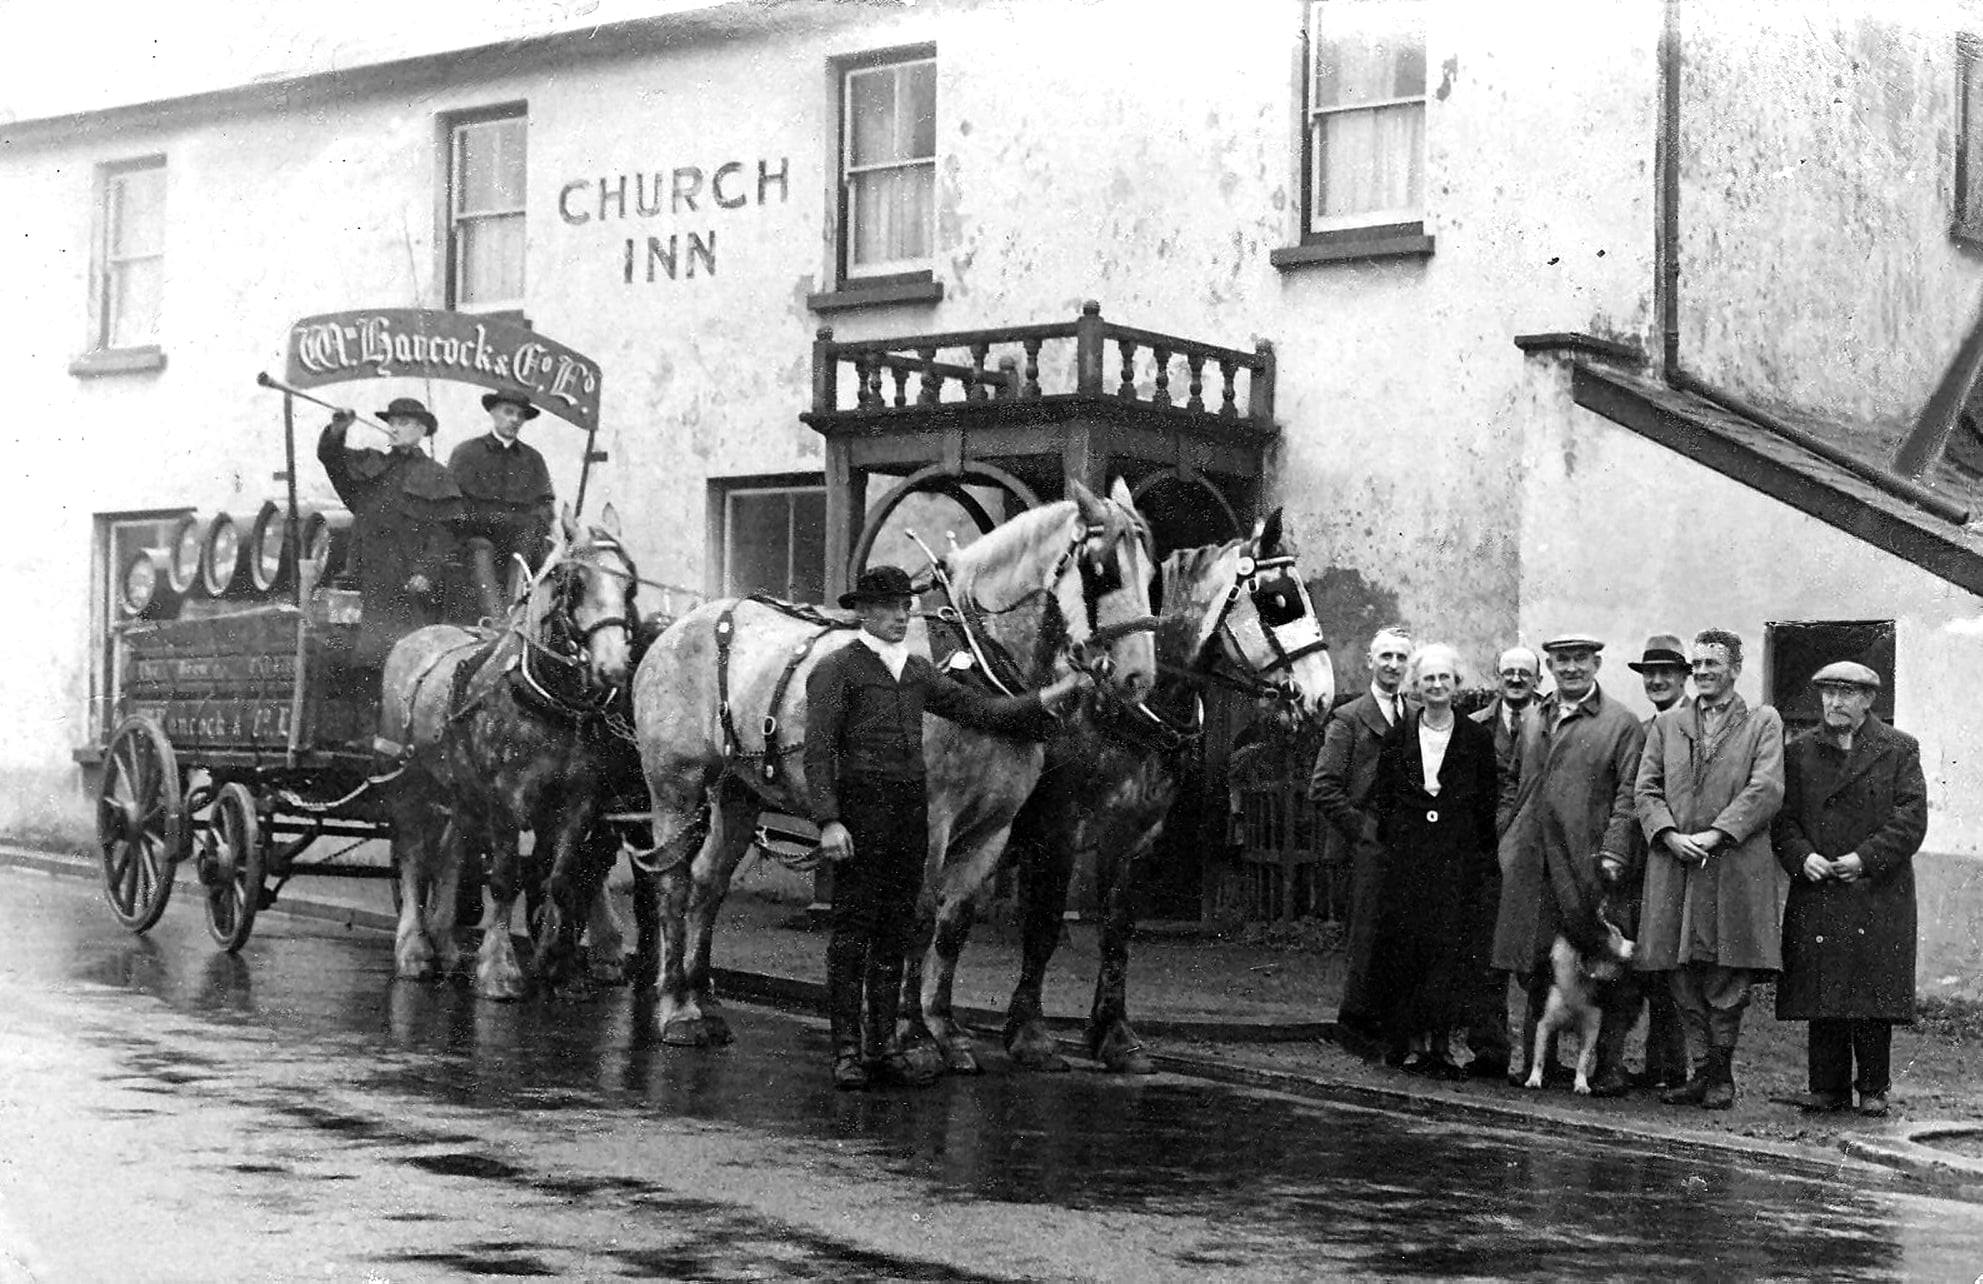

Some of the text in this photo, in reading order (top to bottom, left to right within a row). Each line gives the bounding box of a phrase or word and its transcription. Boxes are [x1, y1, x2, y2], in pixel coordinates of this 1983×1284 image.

[559, 157, 788, 226] CHURCH
[624, 230, 716, 284] INN
[355, 316, 494, 376] Hancock
